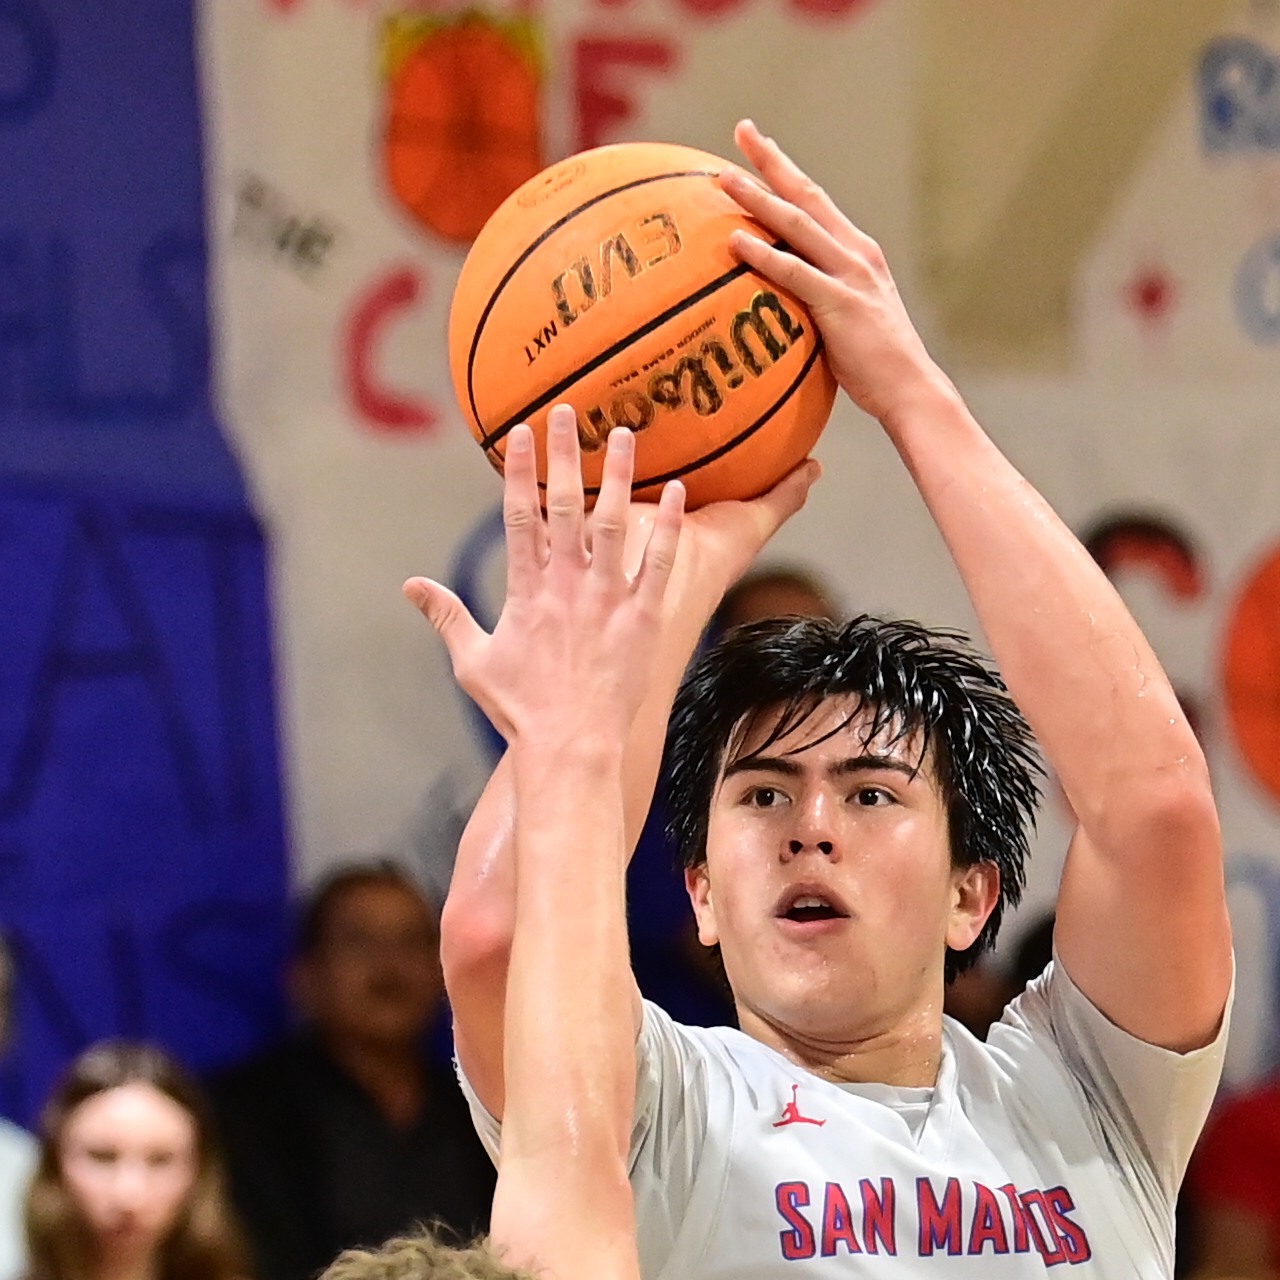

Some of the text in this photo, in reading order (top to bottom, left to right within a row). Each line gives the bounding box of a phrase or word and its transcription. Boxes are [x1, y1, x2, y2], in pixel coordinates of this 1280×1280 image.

[551, 211, 682, 329] EVO
[524, 320, 559, 366] NXT
[577, 289, 804, 452] Wilson
[774, 1175, 1092, 1268] SAN MAOS
